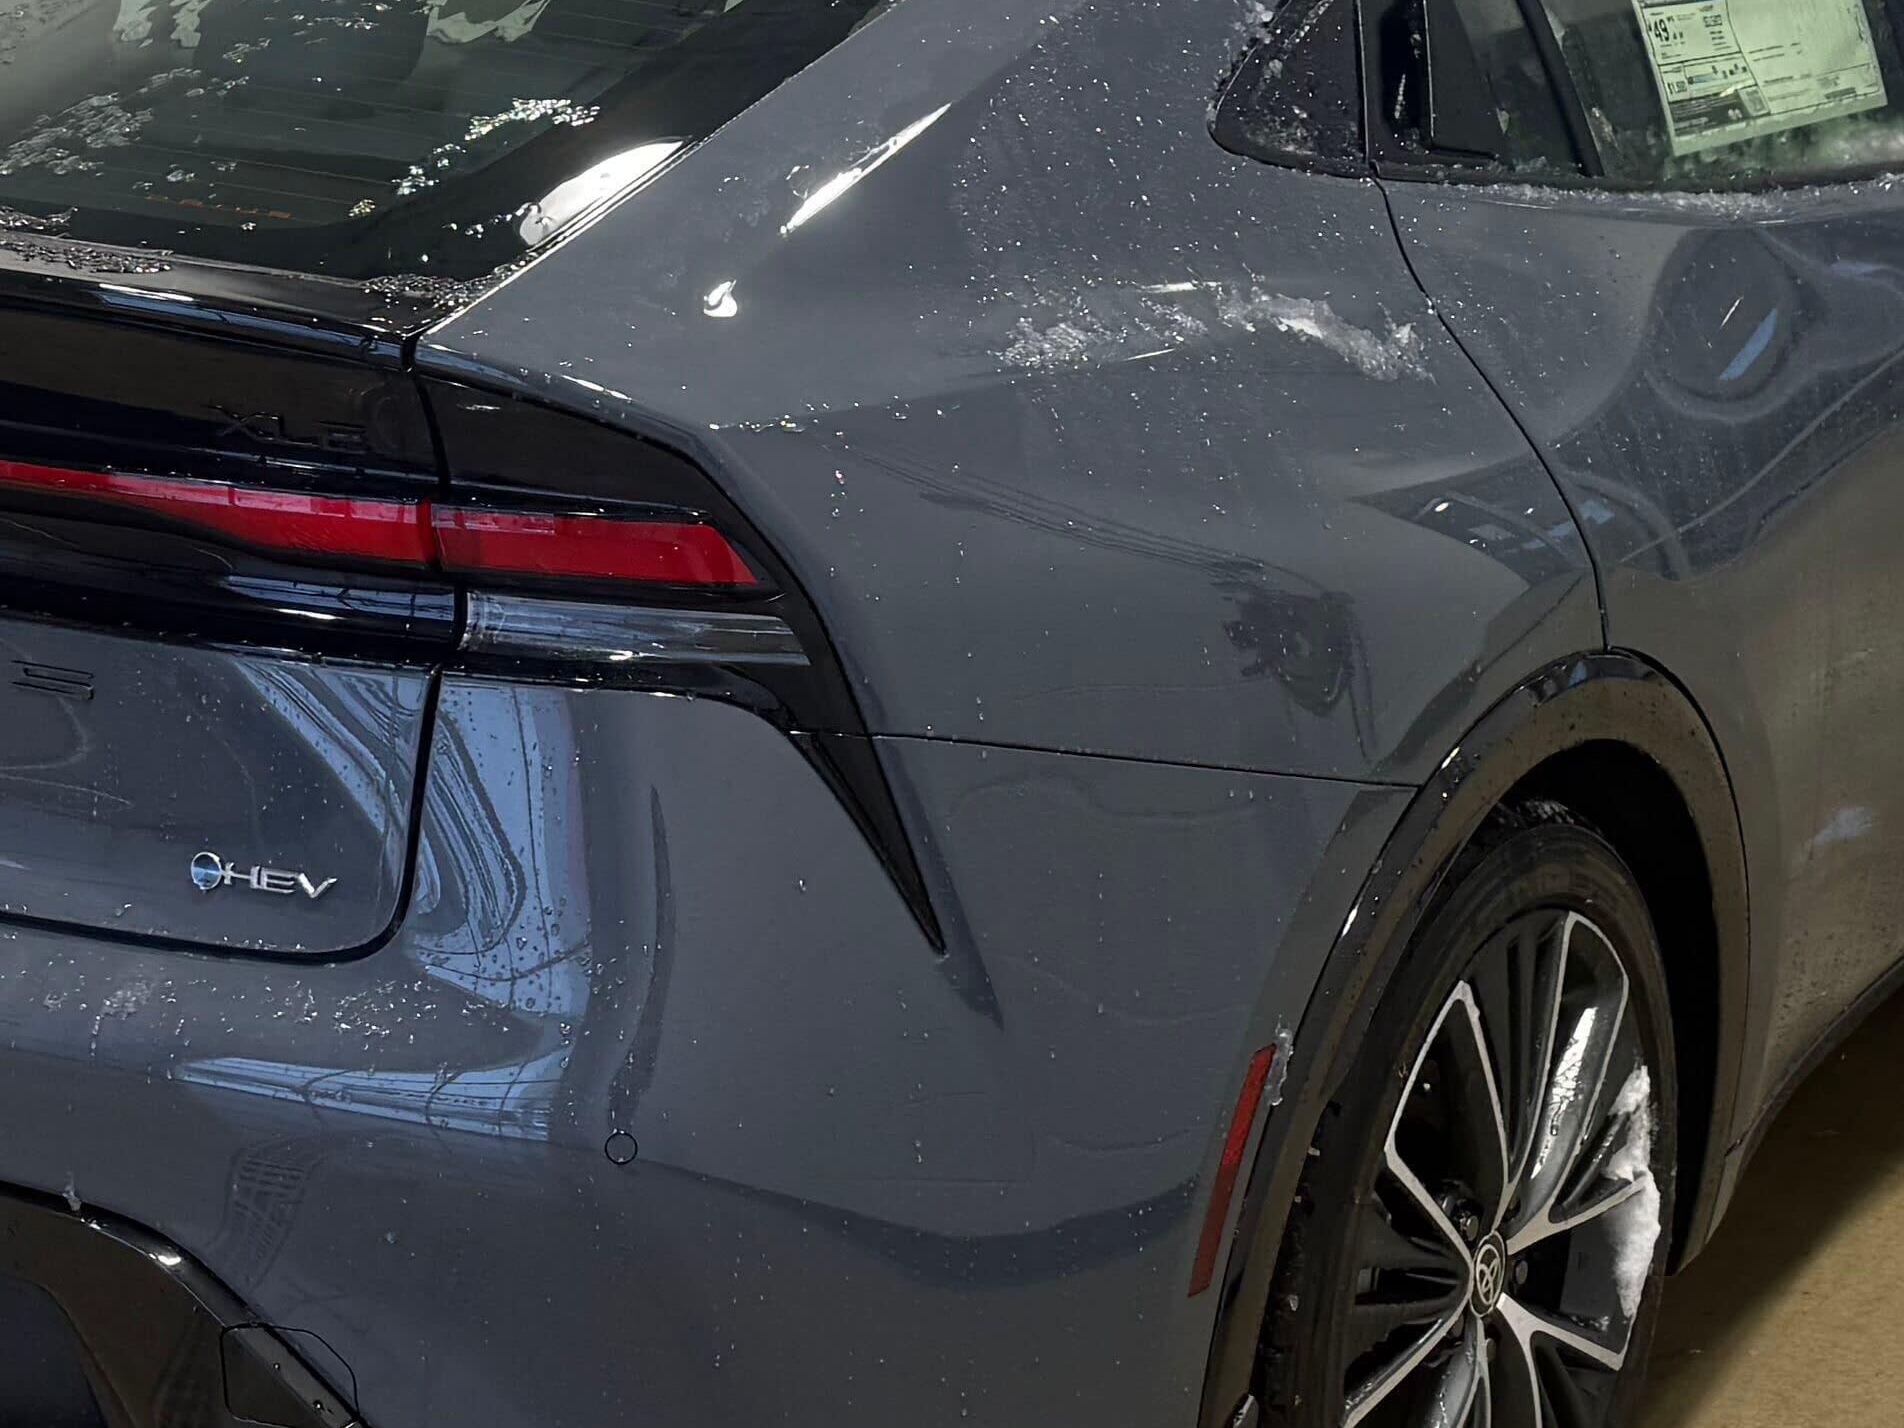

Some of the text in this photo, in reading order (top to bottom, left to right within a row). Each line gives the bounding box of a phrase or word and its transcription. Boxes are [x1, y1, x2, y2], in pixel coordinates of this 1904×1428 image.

[1653, 17, 1670, 43] 49
[208, 404, 367, 455] XLE
[223, 861, 338, 899] HEV
